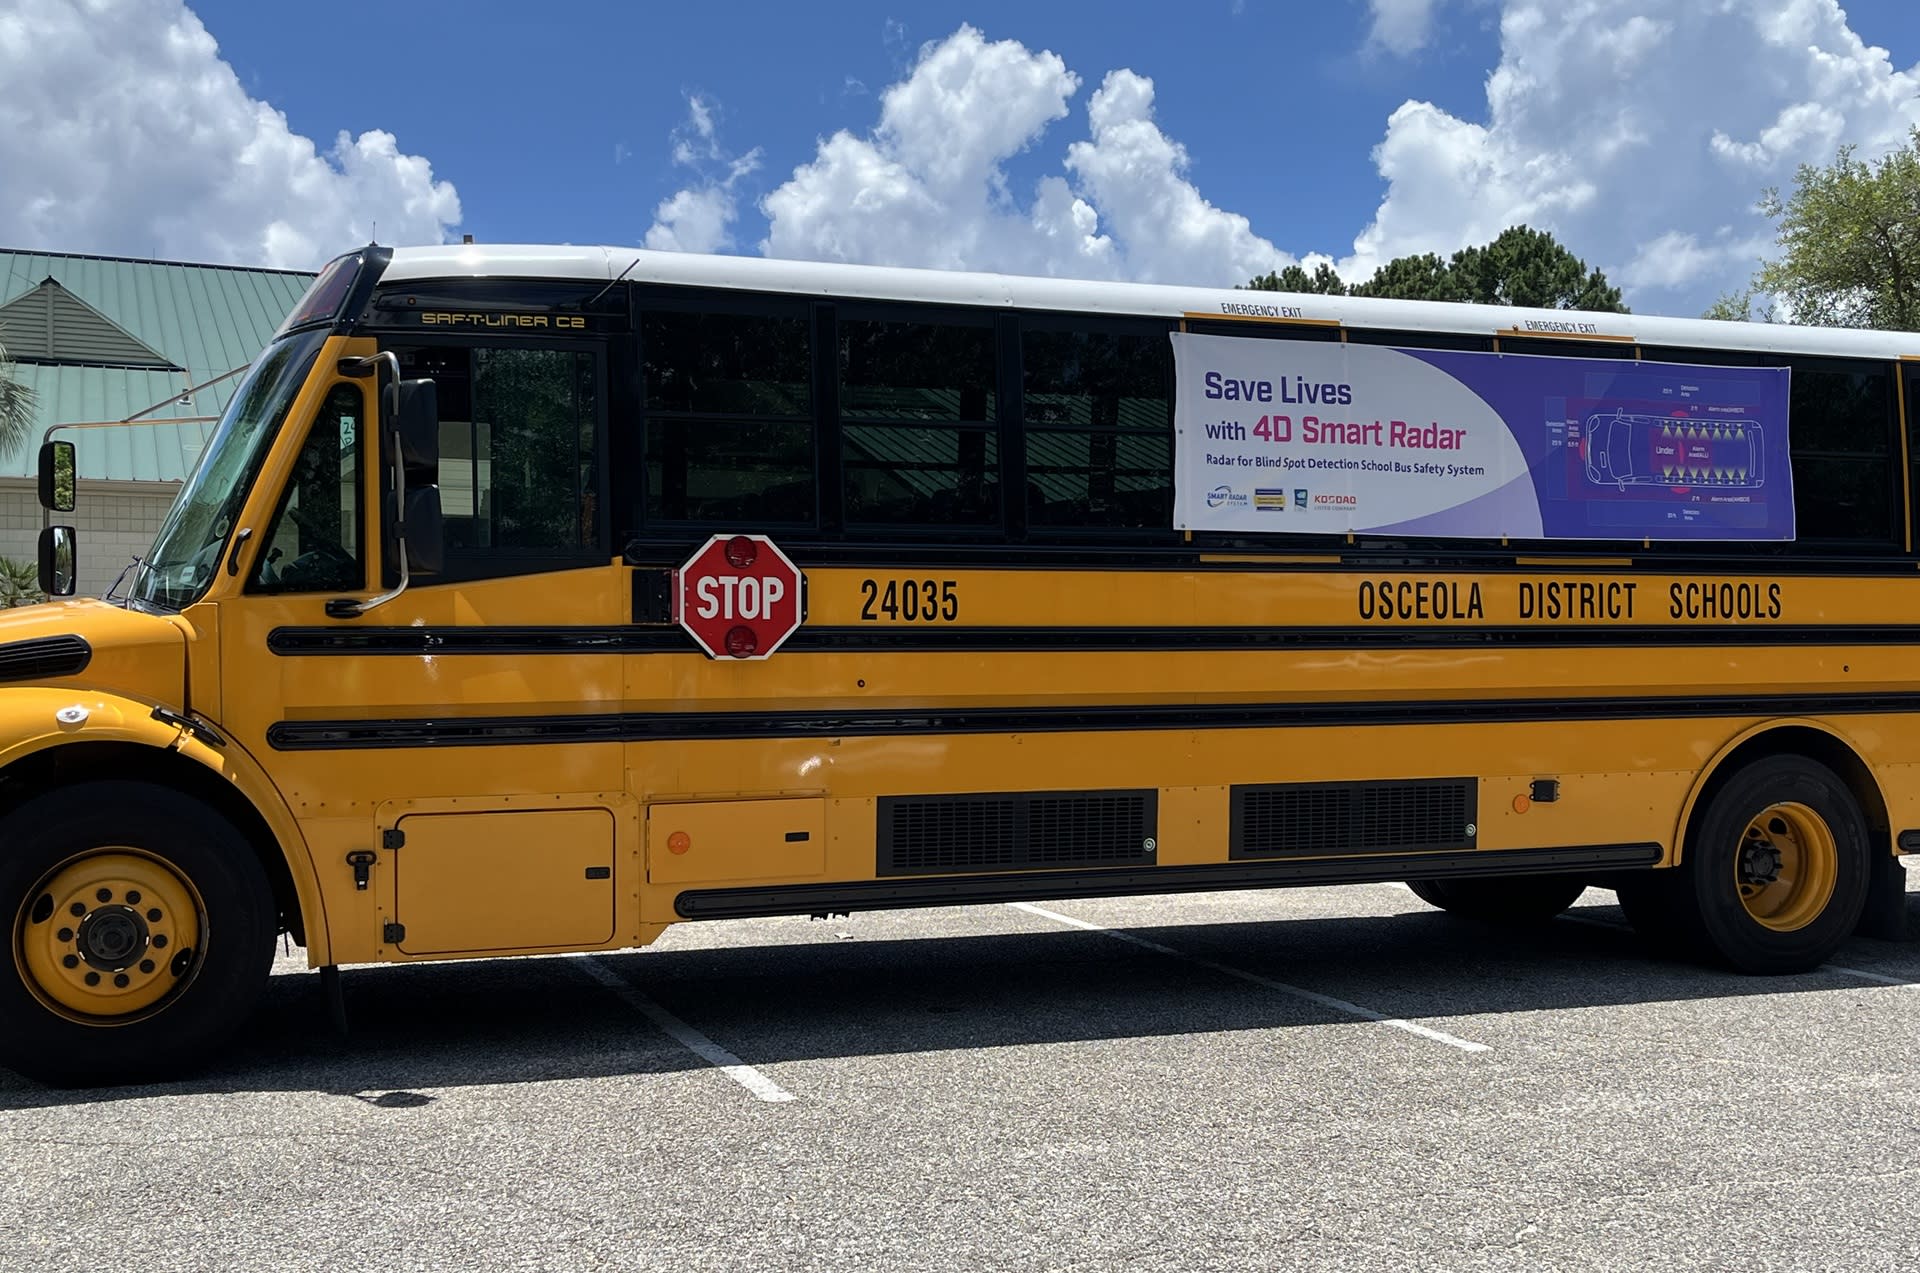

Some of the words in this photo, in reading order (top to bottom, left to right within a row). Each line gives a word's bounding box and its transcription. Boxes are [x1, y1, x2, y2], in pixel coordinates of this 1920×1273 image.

[1221, 302, 1279, 316] EMERGENCY
[1281, 306, 1302, 318] EXIT
[421, 312, 549, 328] SAF-T-LINER
[555, 315, 586, 329] C2
[1524, 319, 1578, 333] EMERGENCY
[1578, 323, 1598, 334] EXIT
[1205, 371, 1273, 402] Save
[1281, 376, 1353, 406] Lives
[1205, 421, 1247, 441] with
[1253, 415, 1292, 443] 4D
[1302, 416, 1384, 447] Smart
[1389, 420, 1467, 451] Radar
[1655, 446, 1675, 455] Under
[1206, 454, 1236, 467] Radar
[1237, 454, 1254, 467] for
[1255, 456, 1282, 469] Blind
[1283, 456, 1306, 471] Spot
[1307, 458, 1360, 471] Detection
[1361, 459, 1394, 473] School
[1395, 462, 1412, 474] Bus
[1413, 462, 1446, 478] Safety
[1447, 464, 1485, 477] System
[1207, 492, 1228, 500] SMART
[1314, 495, 1358, 505] KOSDAQ
[696, 575, 785, 620] STOP
[860, 579, 959, 621] 24035
[1358, 581, 1484, 620] OSCEOLA
[1519, 581, 1637, 620] DISTRICT
[1669, 582, 1782, 621] SCHOOLS
